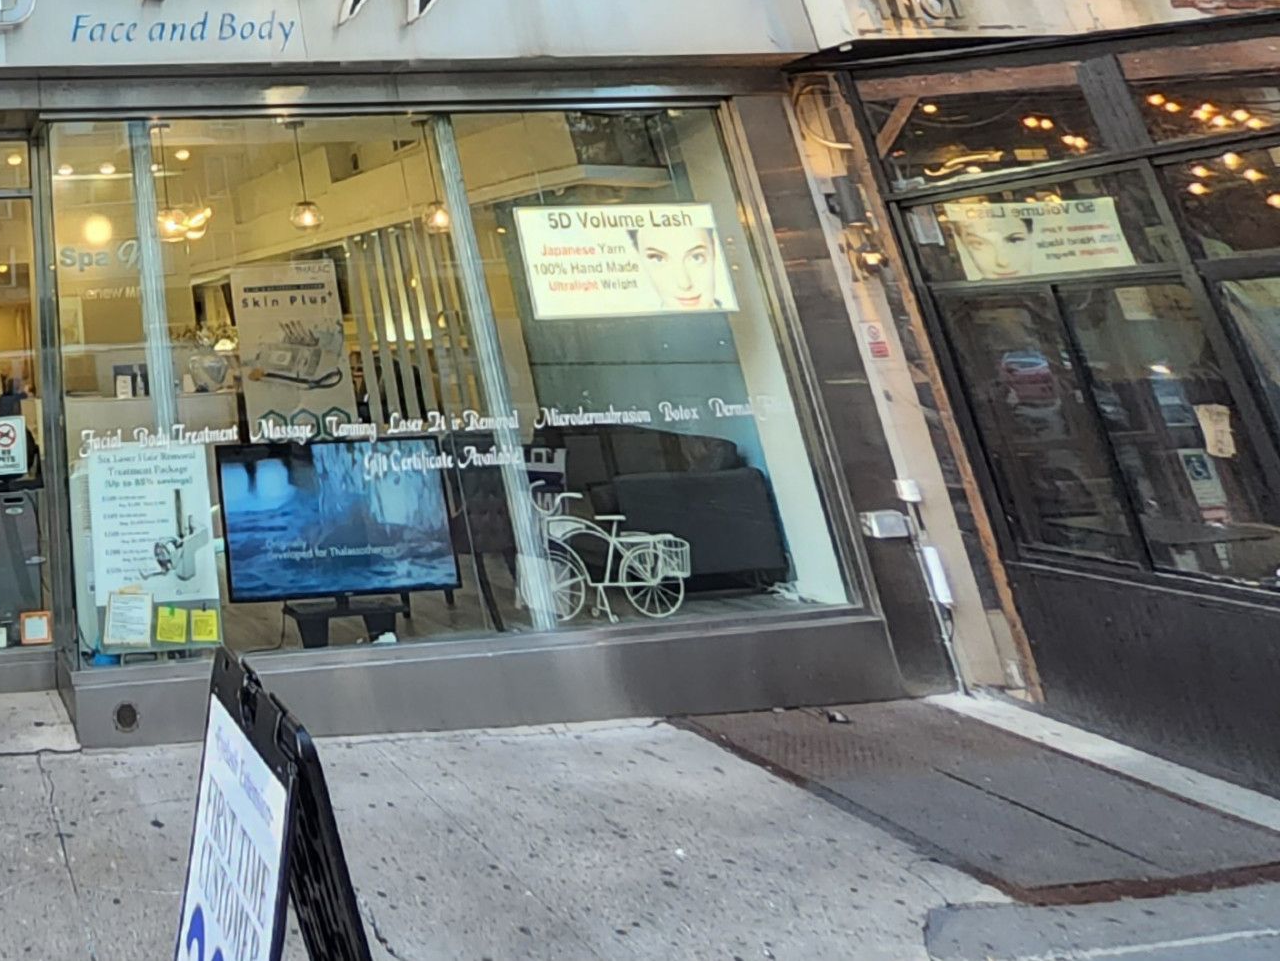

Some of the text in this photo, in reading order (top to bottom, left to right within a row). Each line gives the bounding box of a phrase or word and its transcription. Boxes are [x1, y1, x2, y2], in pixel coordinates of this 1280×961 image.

[71, 10, 295, 52] Face and Body
[548, 210, 692, 229] 5D Volume Lash
[541, 243, 625, 257] Japanese Yarn
[61, 247, 110, 272] Spa
[533, 260, 639, 276] 100% Hand Made
[549, 278, 637, 292] Ultralight Weight
[242, 297, 279, 308] Skin
[79, 428, 122, 457] Facial
[133, 424, 170, 451] Body
[172, 424, 238, 446] Treatment
[250, 418, 314, 445] Massage
[325, 416, 377, 443] Tanning
[387, 411, 423, 434] Laser
[463, 409, 519, 432] Removal
[534, 404, 651, 428] Microdermabrasion
[658, 401, 700, 422] Botox
[160, 450, 196, 461] Removal
[391, 448, 454, 475] Certificate
[458, 444, 522, 469] Available
[108, 465, 188, 477] Treatment Package
